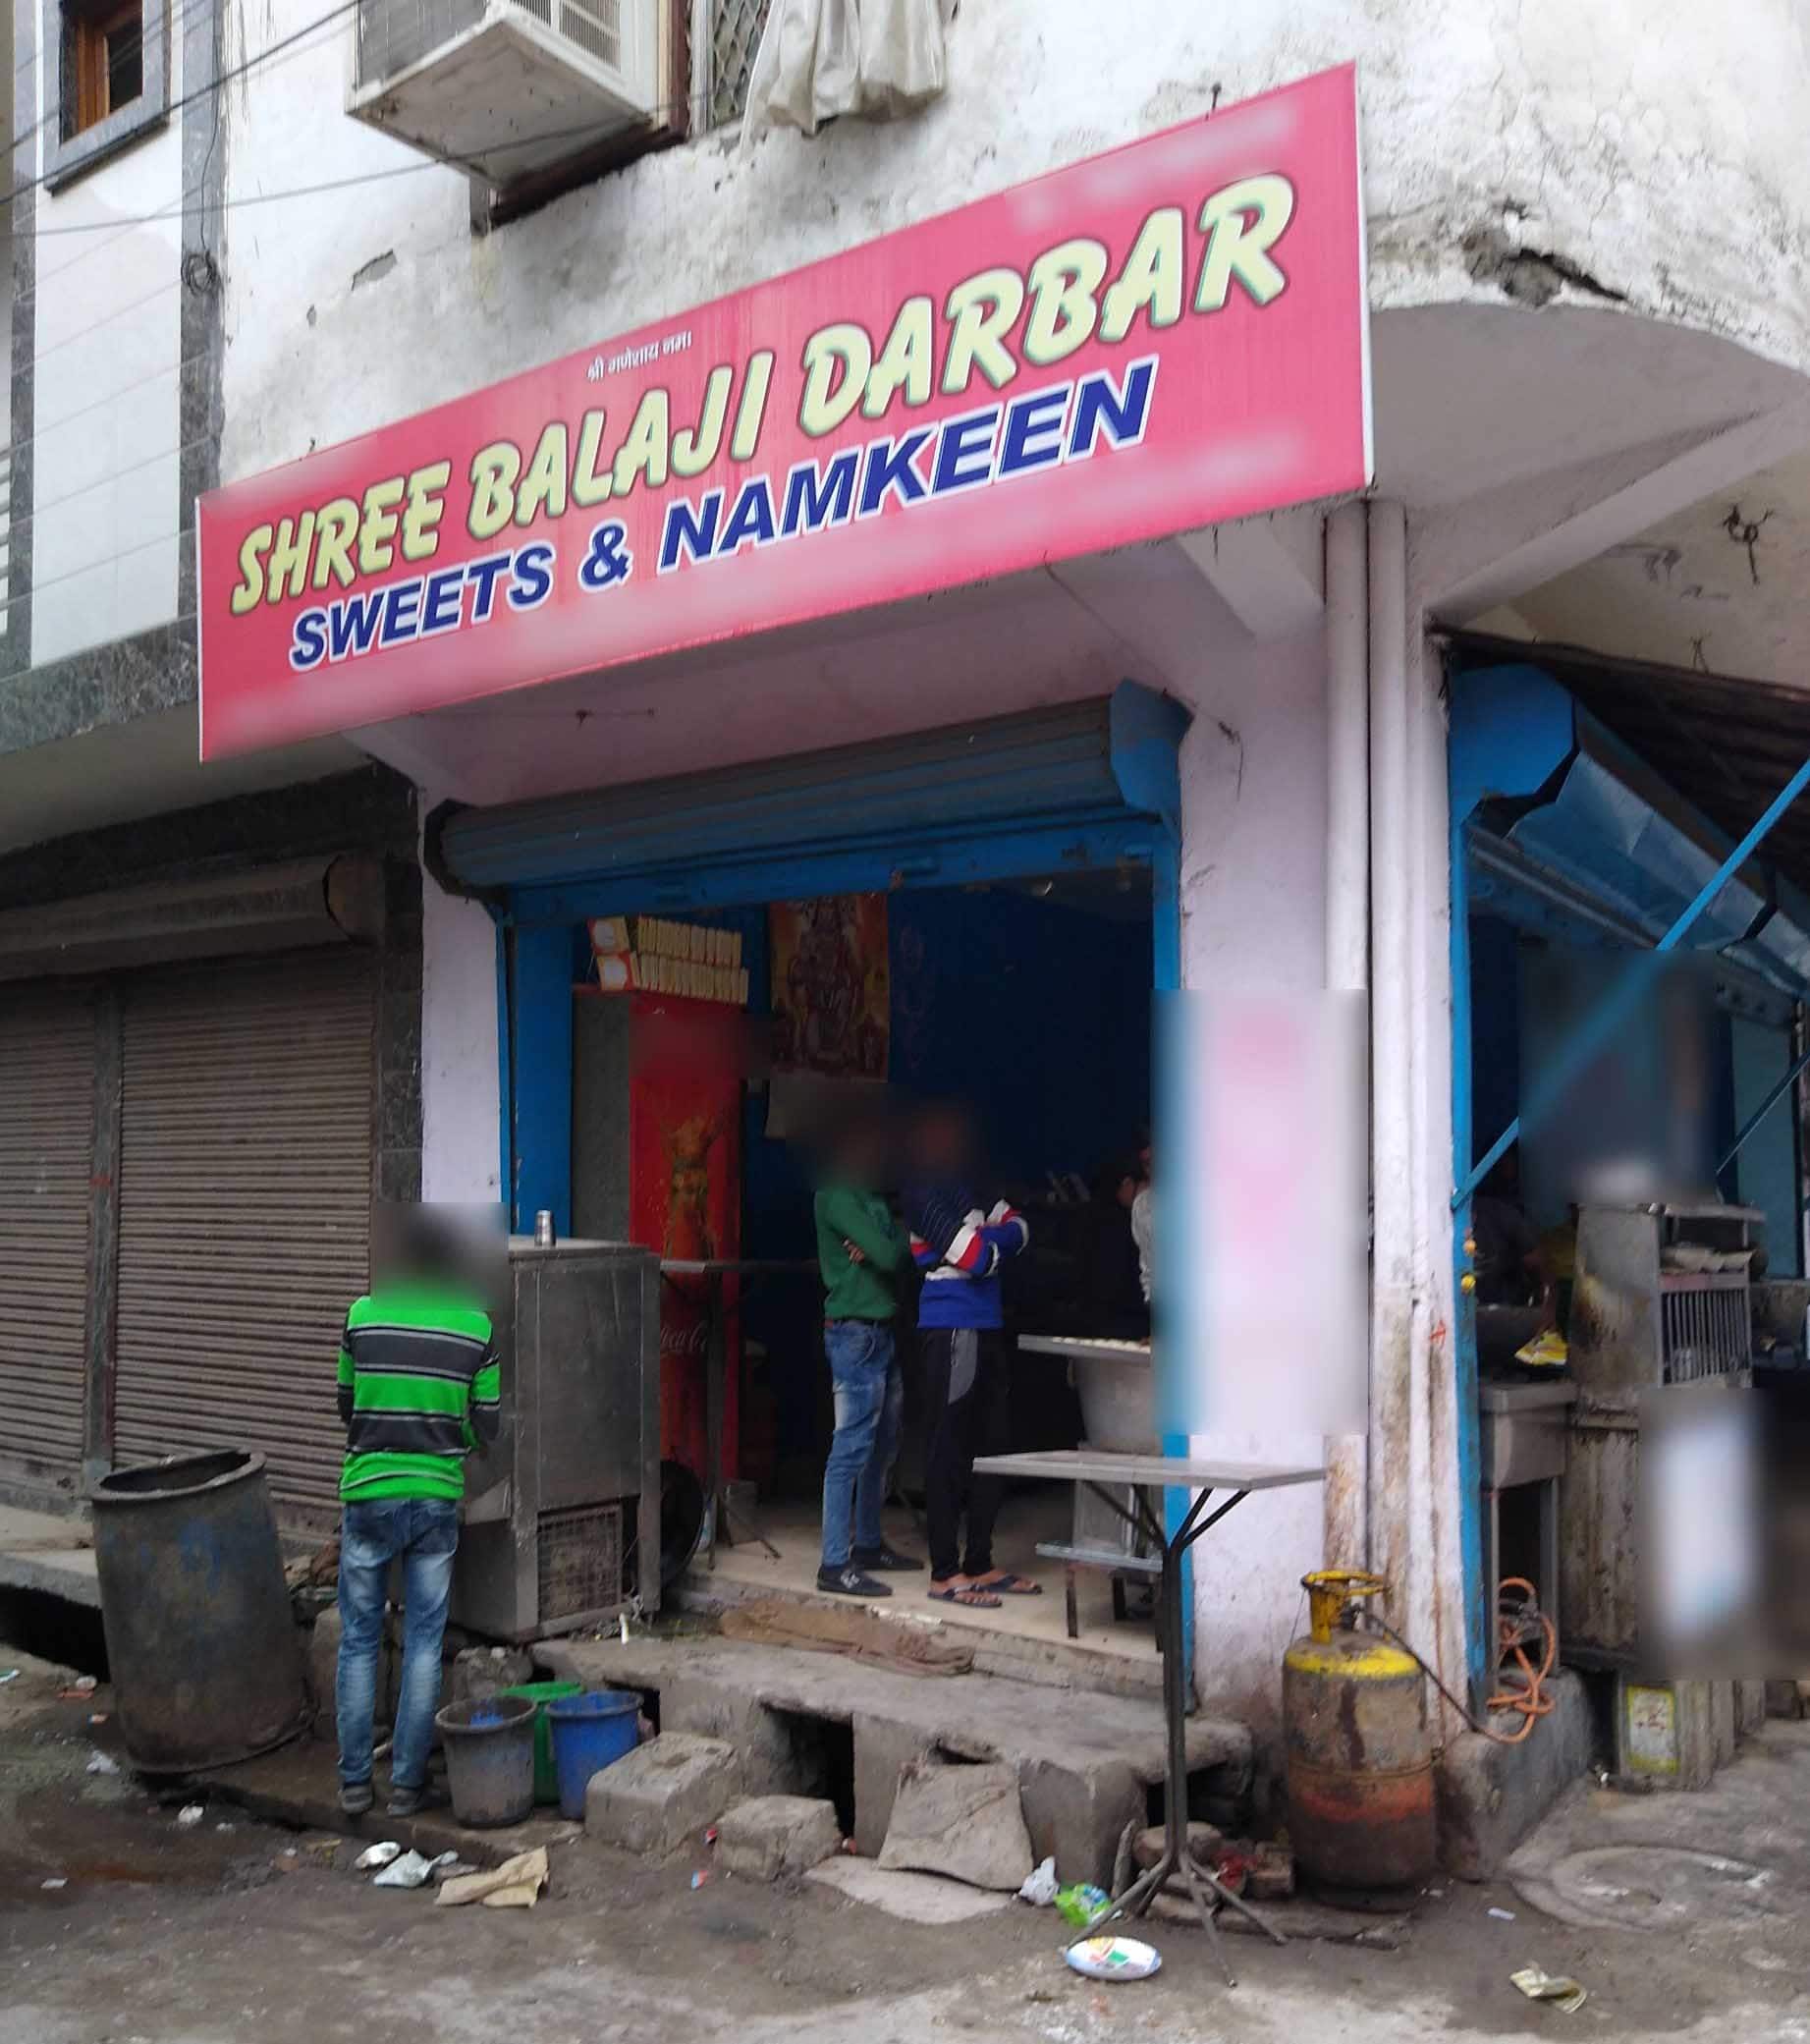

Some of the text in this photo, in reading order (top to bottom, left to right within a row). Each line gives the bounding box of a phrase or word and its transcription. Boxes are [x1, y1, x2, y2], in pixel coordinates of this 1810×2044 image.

[230, 172, 1294, 616] SHREE BALAJI DARBAR
[290, 355, 1159, 670] SWEETS & NAMKEEN
[587, 355, 604, 382] श्री
